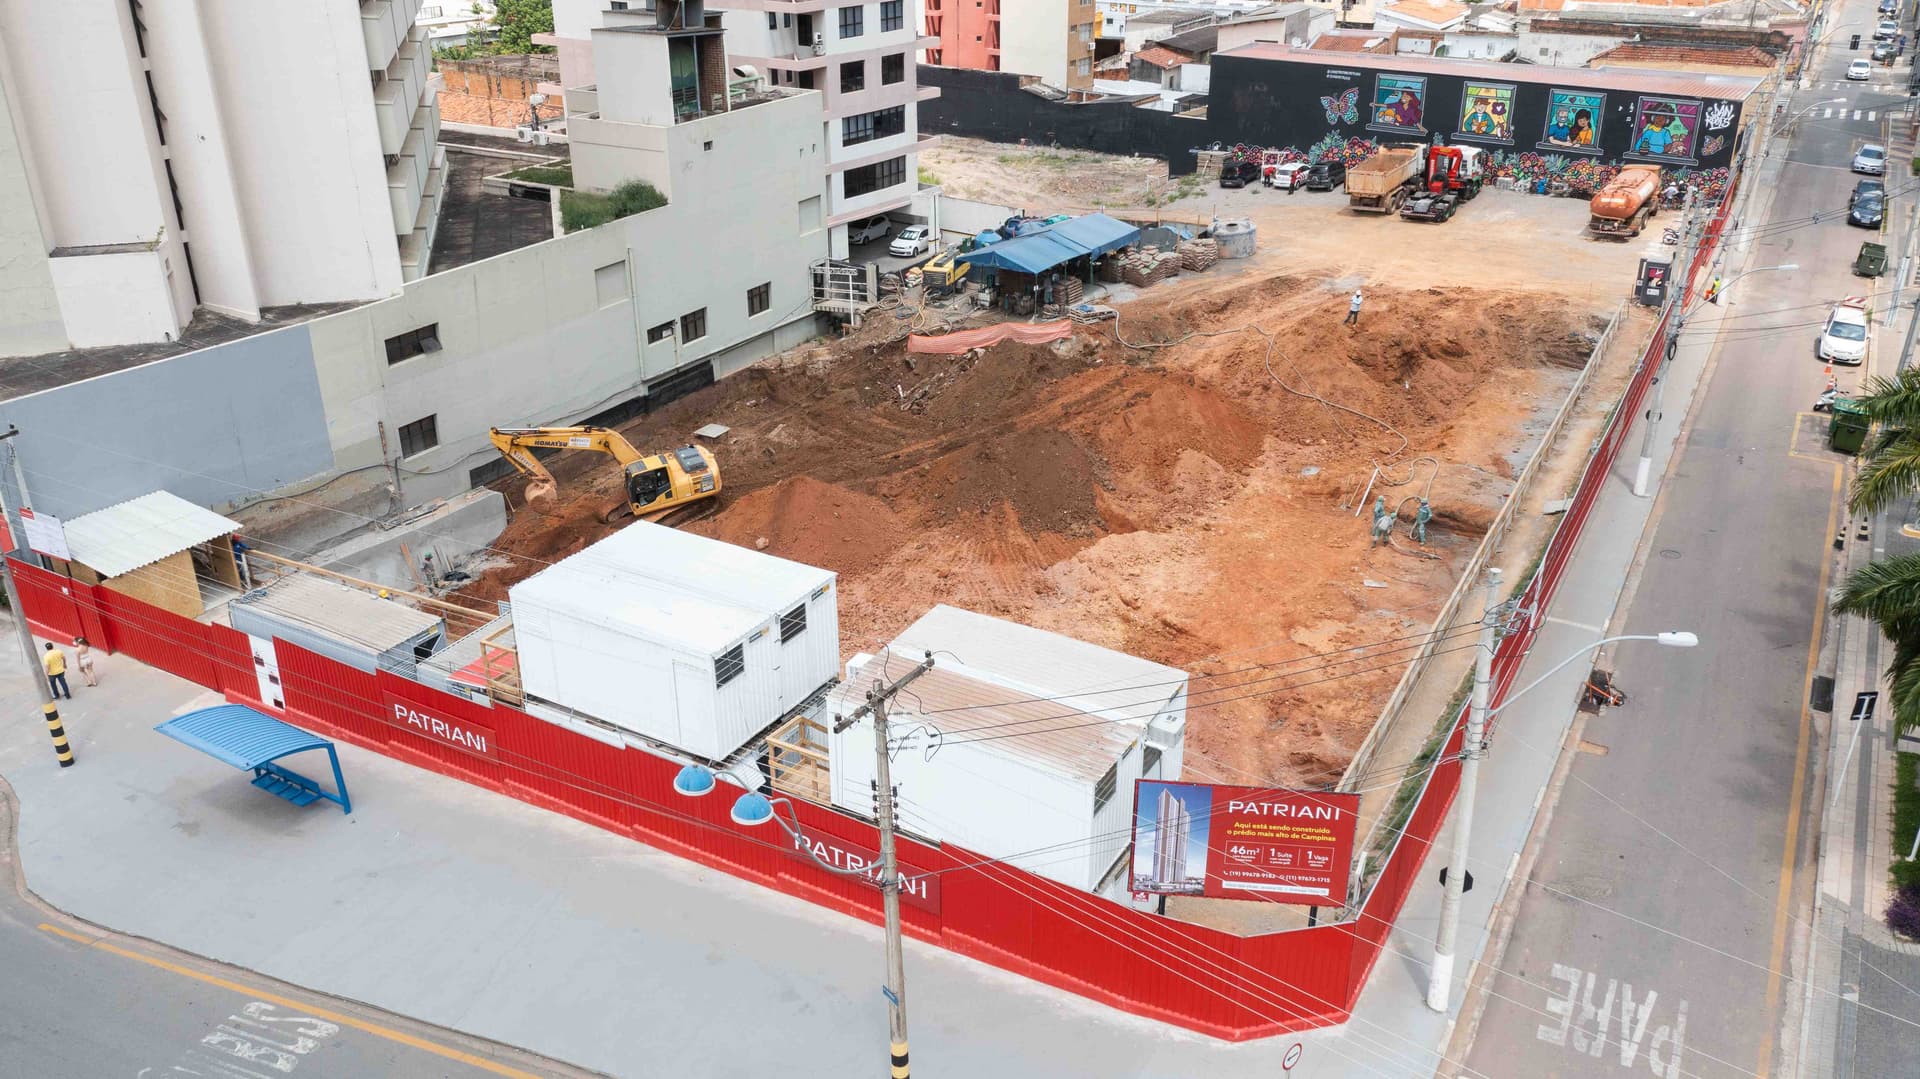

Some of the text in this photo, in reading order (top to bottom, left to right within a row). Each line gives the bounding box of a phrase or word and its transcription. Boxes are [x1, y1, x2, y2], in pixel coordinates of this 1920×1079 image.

[394, 703, 487, 752] PATRIANI
[1228, 800, 1341, 820] PATRIANI
[1234, 821, 1251, 829] Aqui
[1301, 834, 1337, 842] Campinas
[1269, 848, 1276, 857] 1
[1306, 851, 1313, 860] 1
[794, 832, 927, 899] PATRINI
[1536, 962, 1688, 1079] PARE
